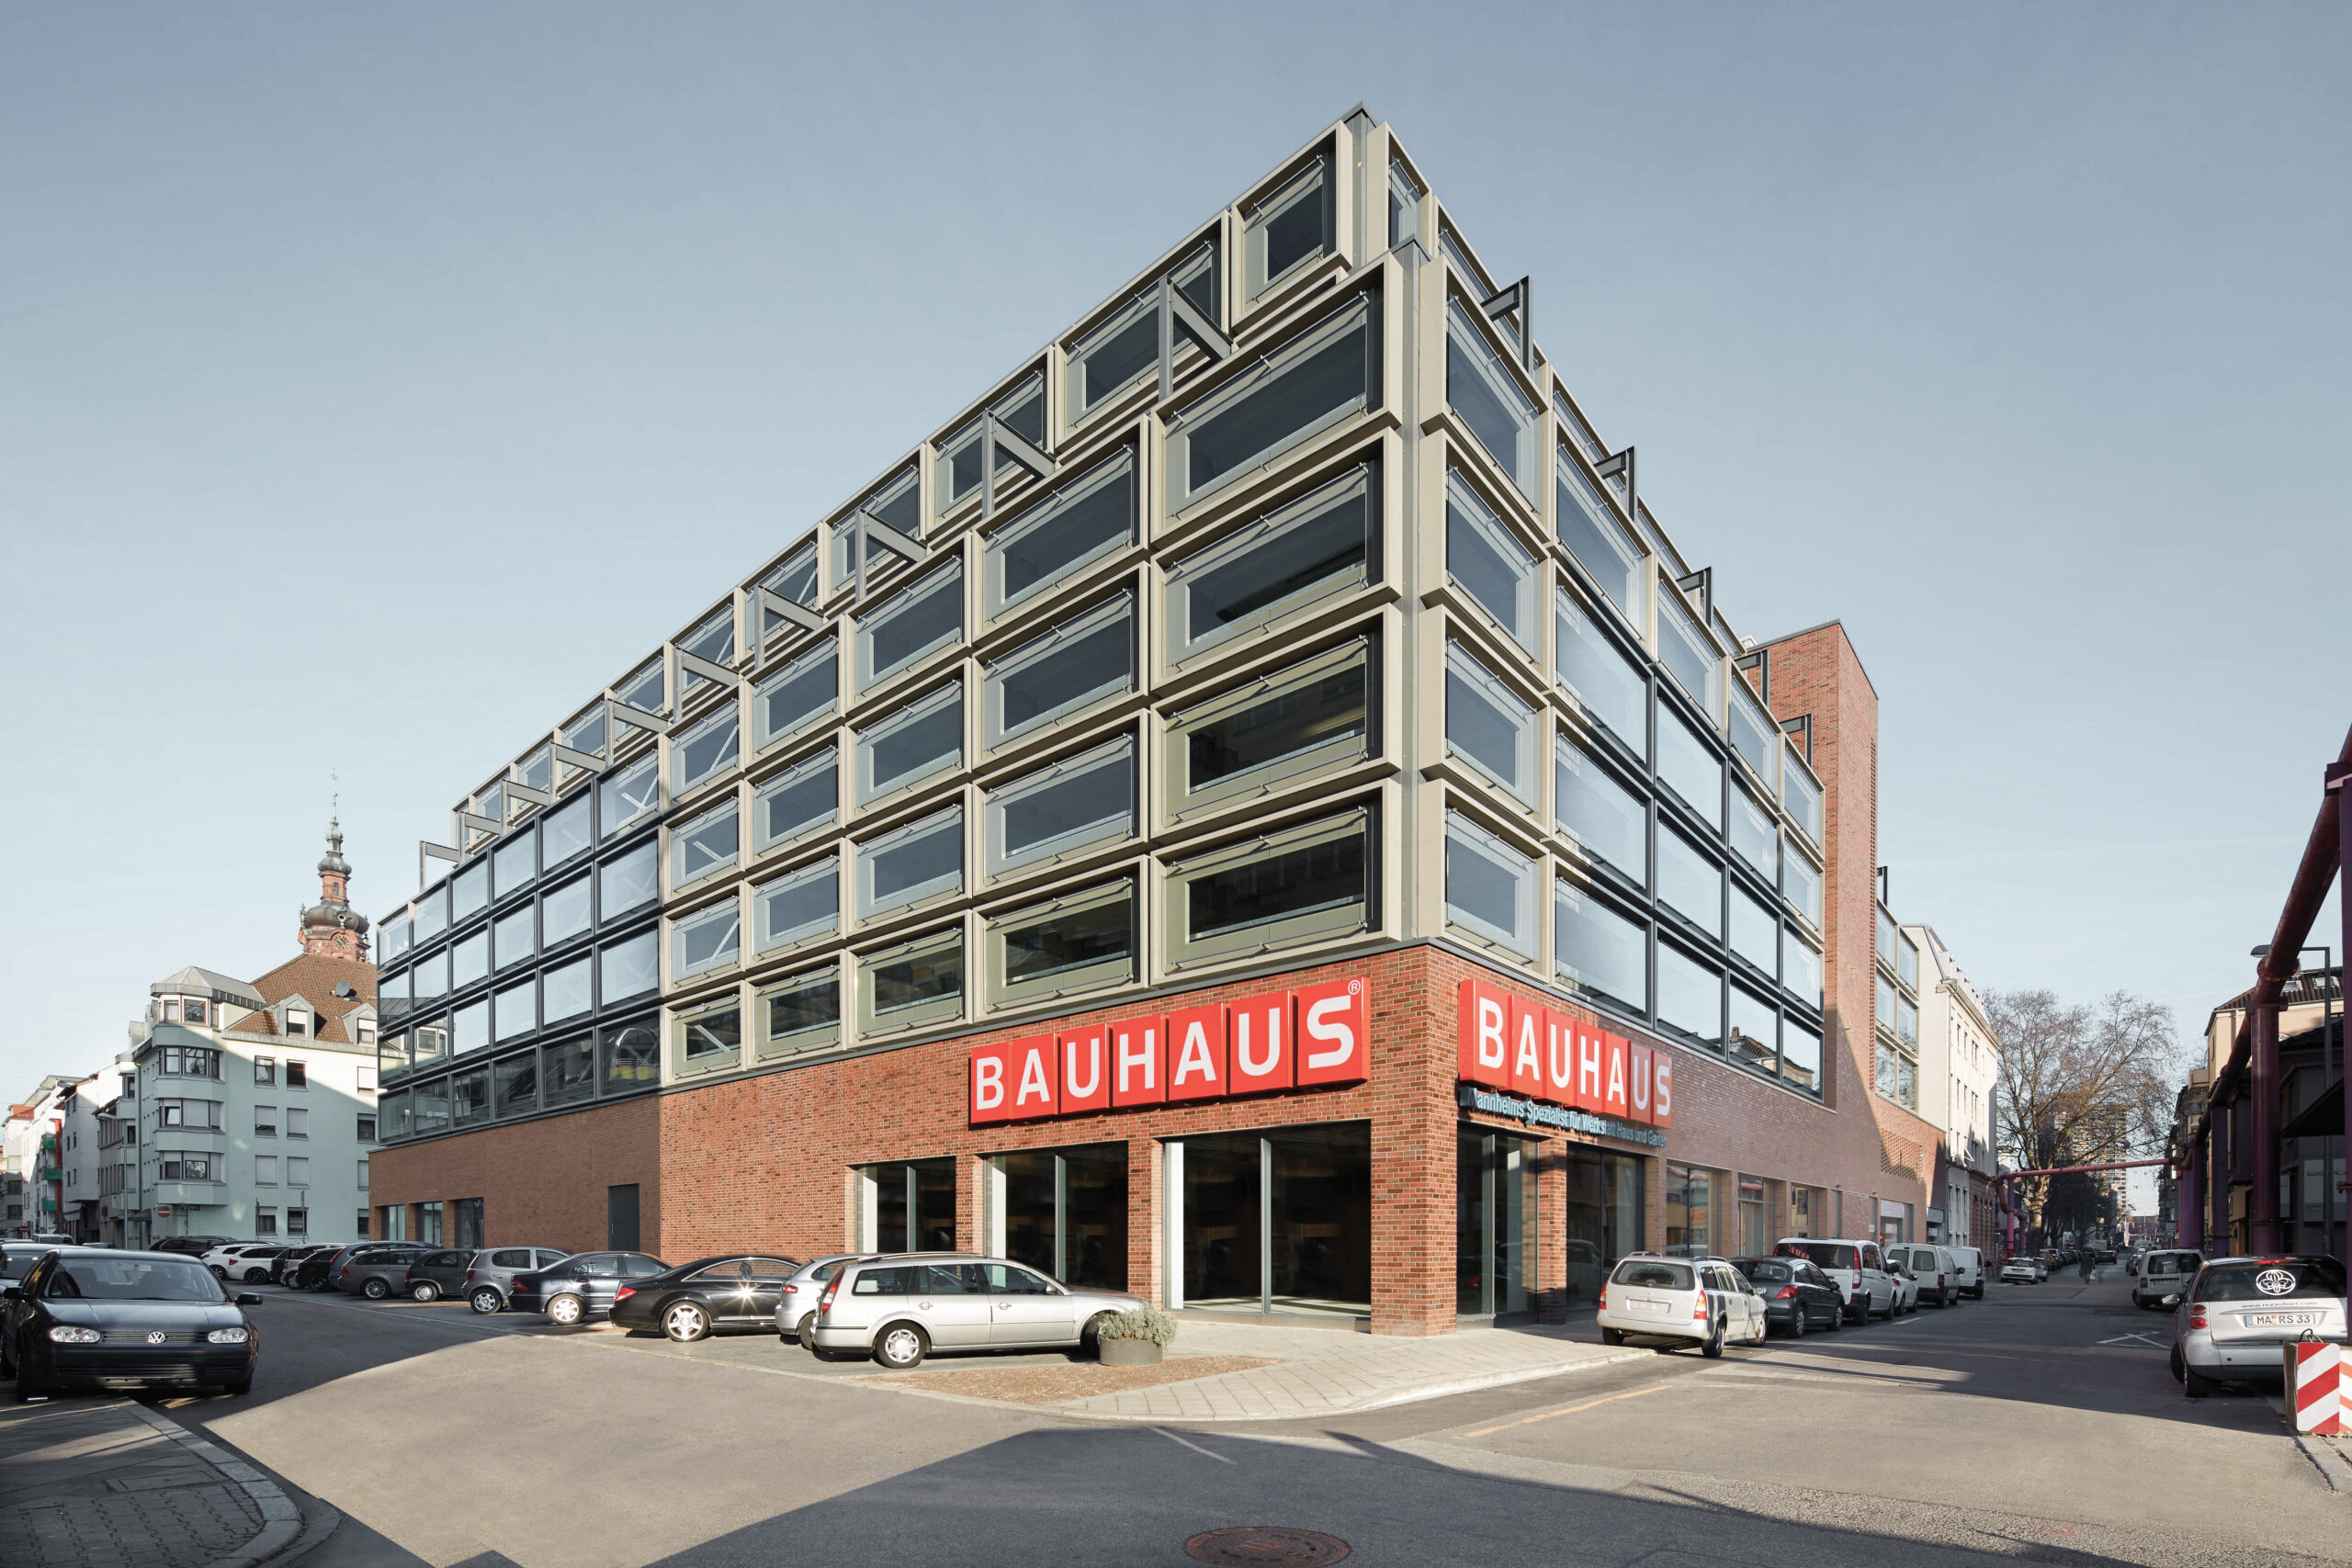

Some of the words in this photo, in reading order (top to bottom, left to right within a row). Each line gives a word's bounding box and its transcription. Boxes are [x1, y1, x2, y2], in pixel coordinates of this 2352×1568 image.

[1478, 997, 1670, 1116] BAUHAUS
[1526, 1100, 1568, 1128] Spezialist
[1570, 1111, 1581, 1131] für
[1582, 1114, 1616, 1137] Werkstatt
[1617, 1122, 1634, 1141] Haus
[1635, 1129, 1647, 1143] und
[1648, 1130, 1668, 1147] Garten
[2256, 1314, 2272, 1325] MA
[2278, 1314, 2294, 1324] RS
[2296, 1314, 2311, 1324] 33
